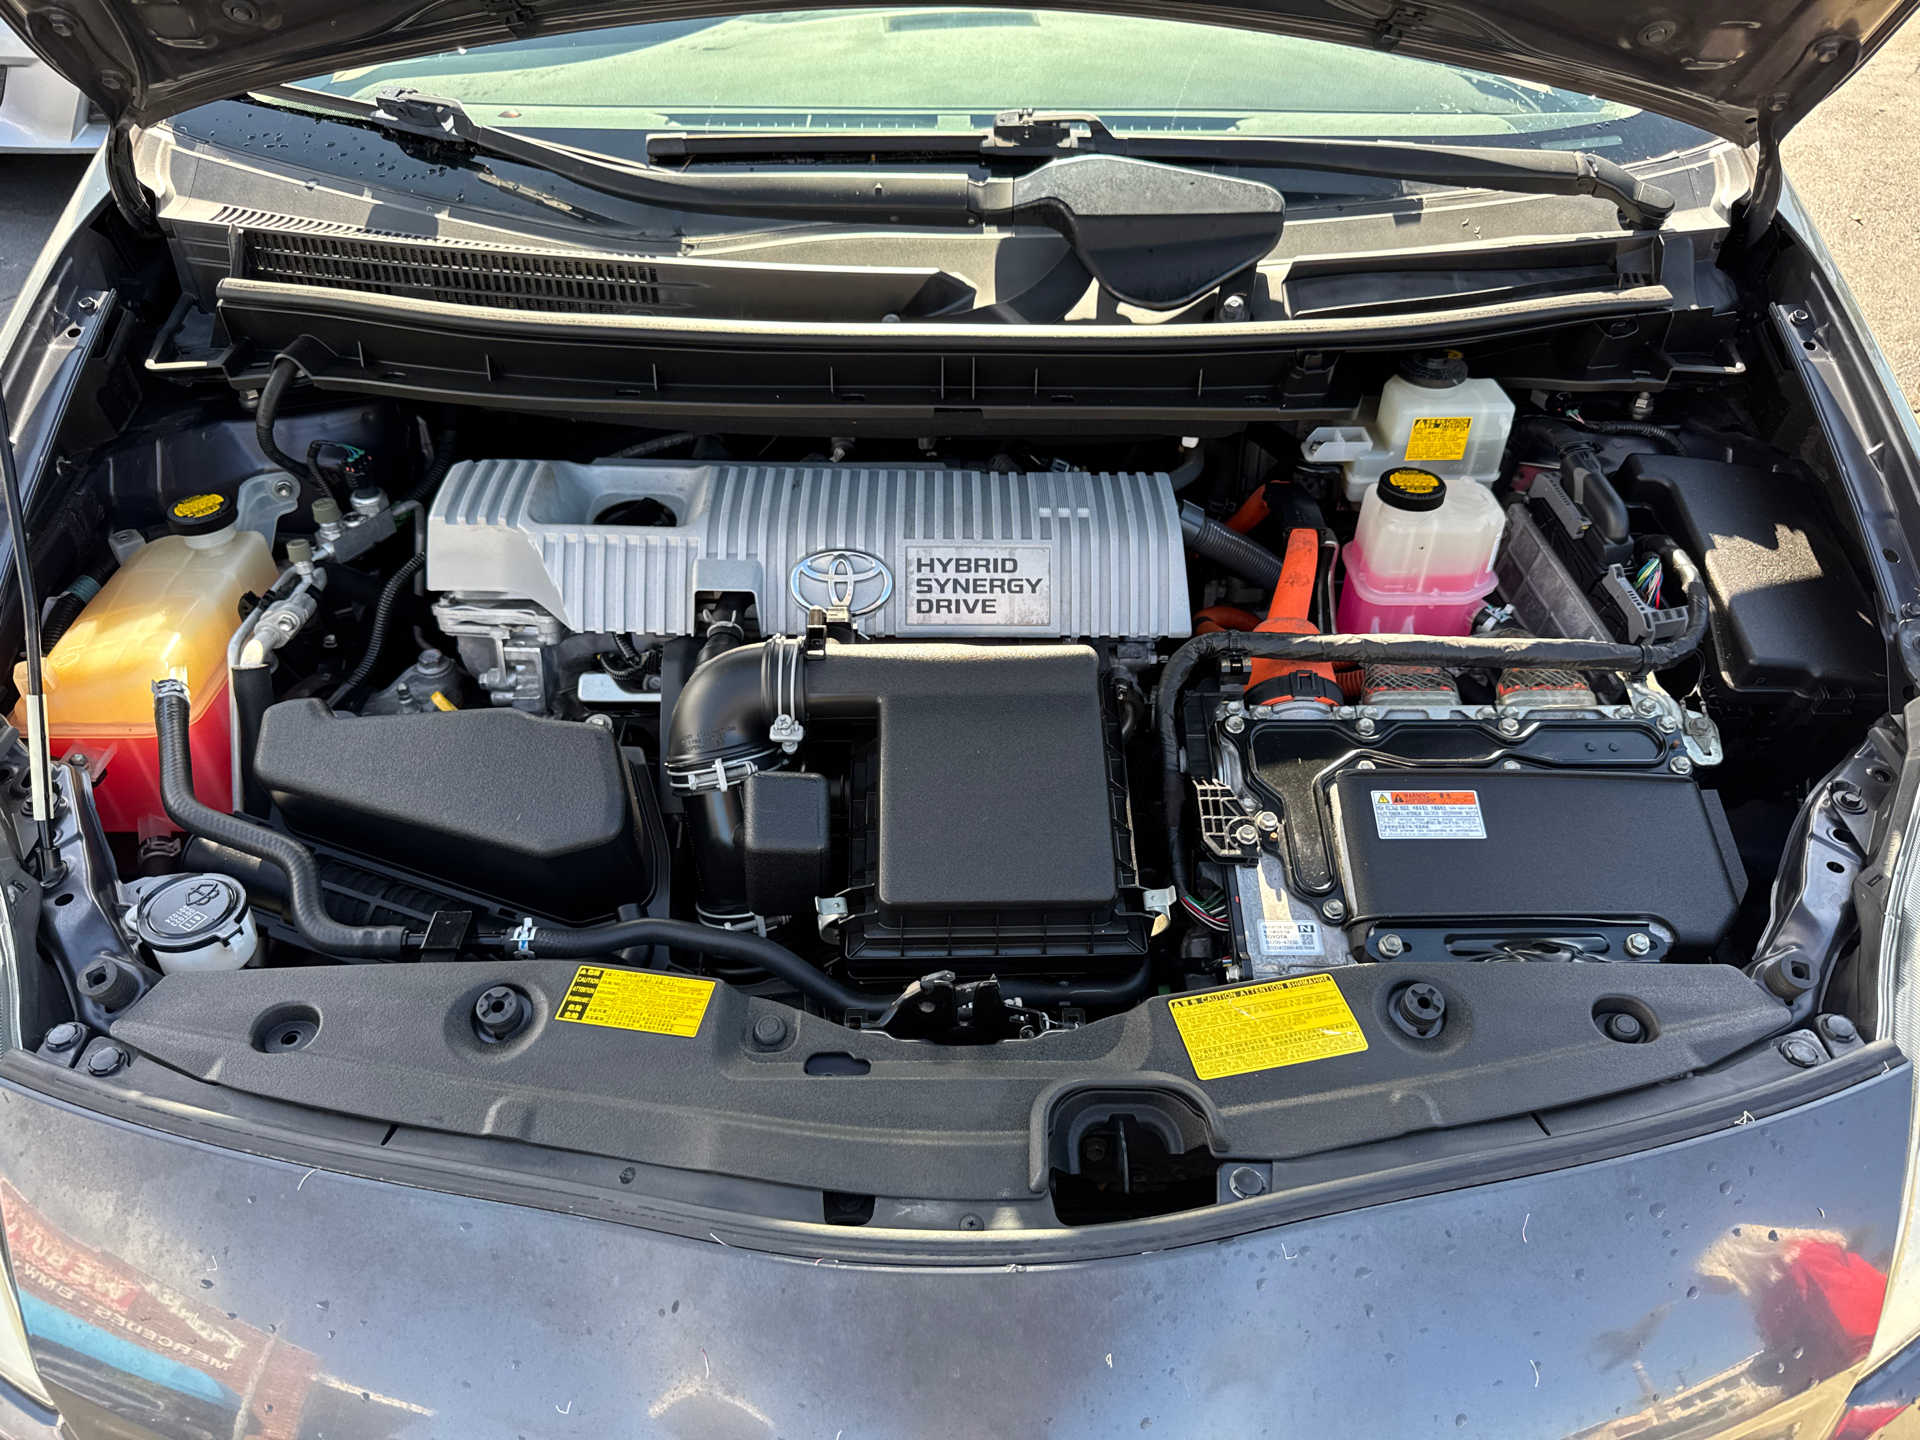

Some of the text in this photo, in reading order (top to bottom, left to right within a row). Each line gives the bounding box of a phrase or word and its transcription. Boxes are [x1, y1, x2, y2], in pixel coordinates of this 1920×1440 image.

[916, 557, 1018, 573] HYBRID
[916, 578, 1043, 594] SYNERGY
[916, 599, 997, 614] DRIVE
[577, 976, 600, 984] CAUTION
[572, 985, 596, 994] ATTENTION
[1202, 984, 1284, 1003] CAUTION ATTENTION
[1196, 1053, 1217, 1061] READY
